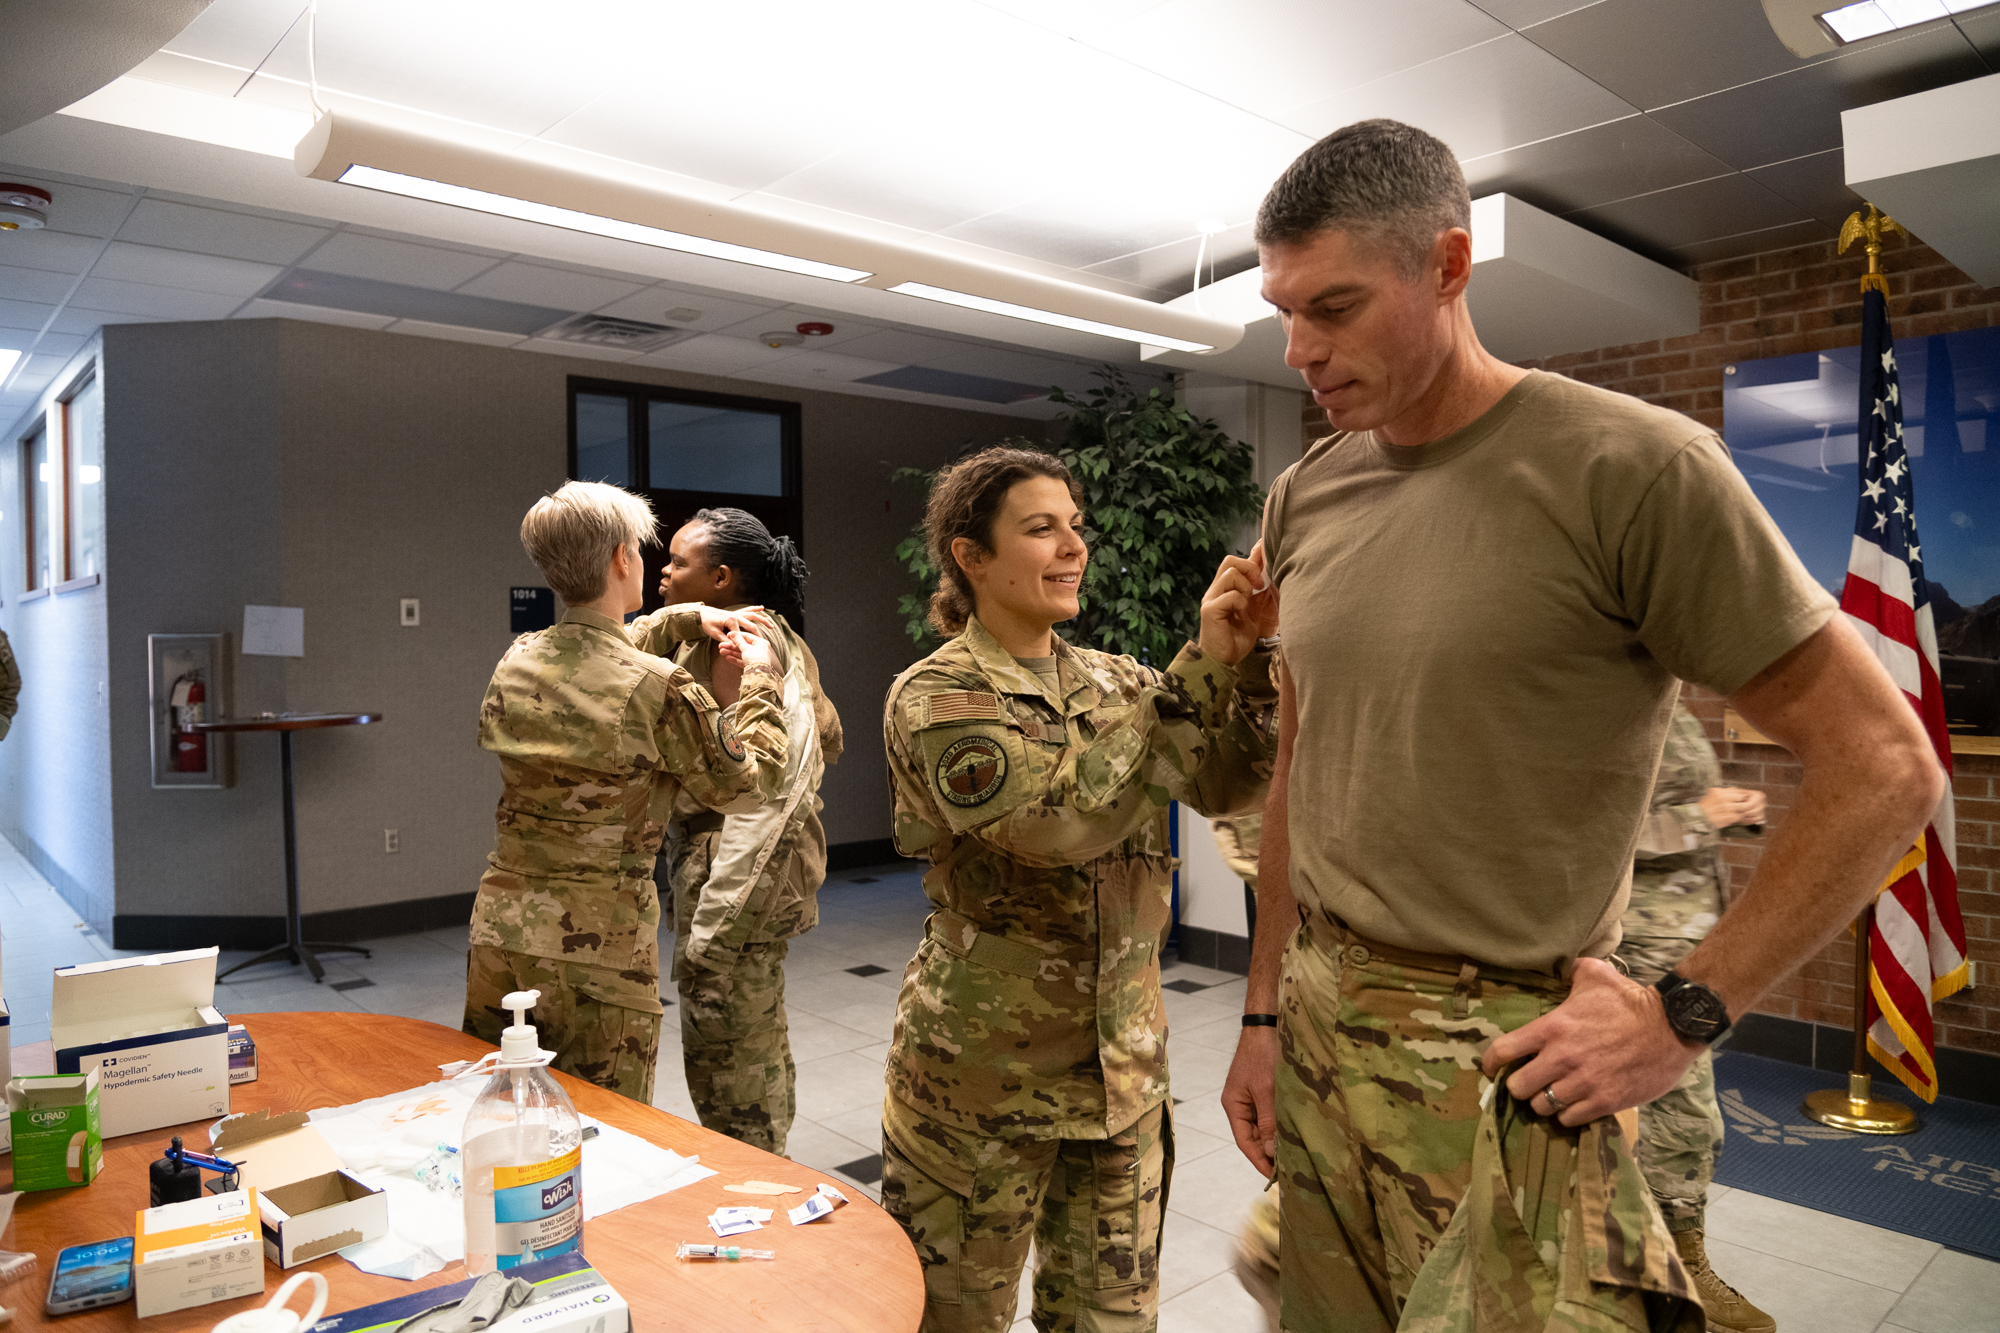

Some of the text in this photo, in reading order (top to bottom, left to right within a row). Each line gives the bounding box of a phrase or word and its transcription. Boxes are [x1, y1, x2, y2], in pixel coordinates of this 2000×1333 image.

[513, 589, 537, 599] 1014
[953, 738, 998, 753] AEROMEDICAL
[103, 1065, 148, 1079] Magellan
[104, 1067, 203, 1090] Hypodermic Safety Needle
[229, 1071, 249, 1079] Ansell
[31, 1111, 66, 1123] CURAD
[543, 1181, 573, 1206] Wish
[540, 1220, 556, 1229] HAND
[75, 1246, 119, 1260] 10:06
[549, 1282, 597, 1298] STERLING
[522, 1300, 590, 1324] HALYARD
